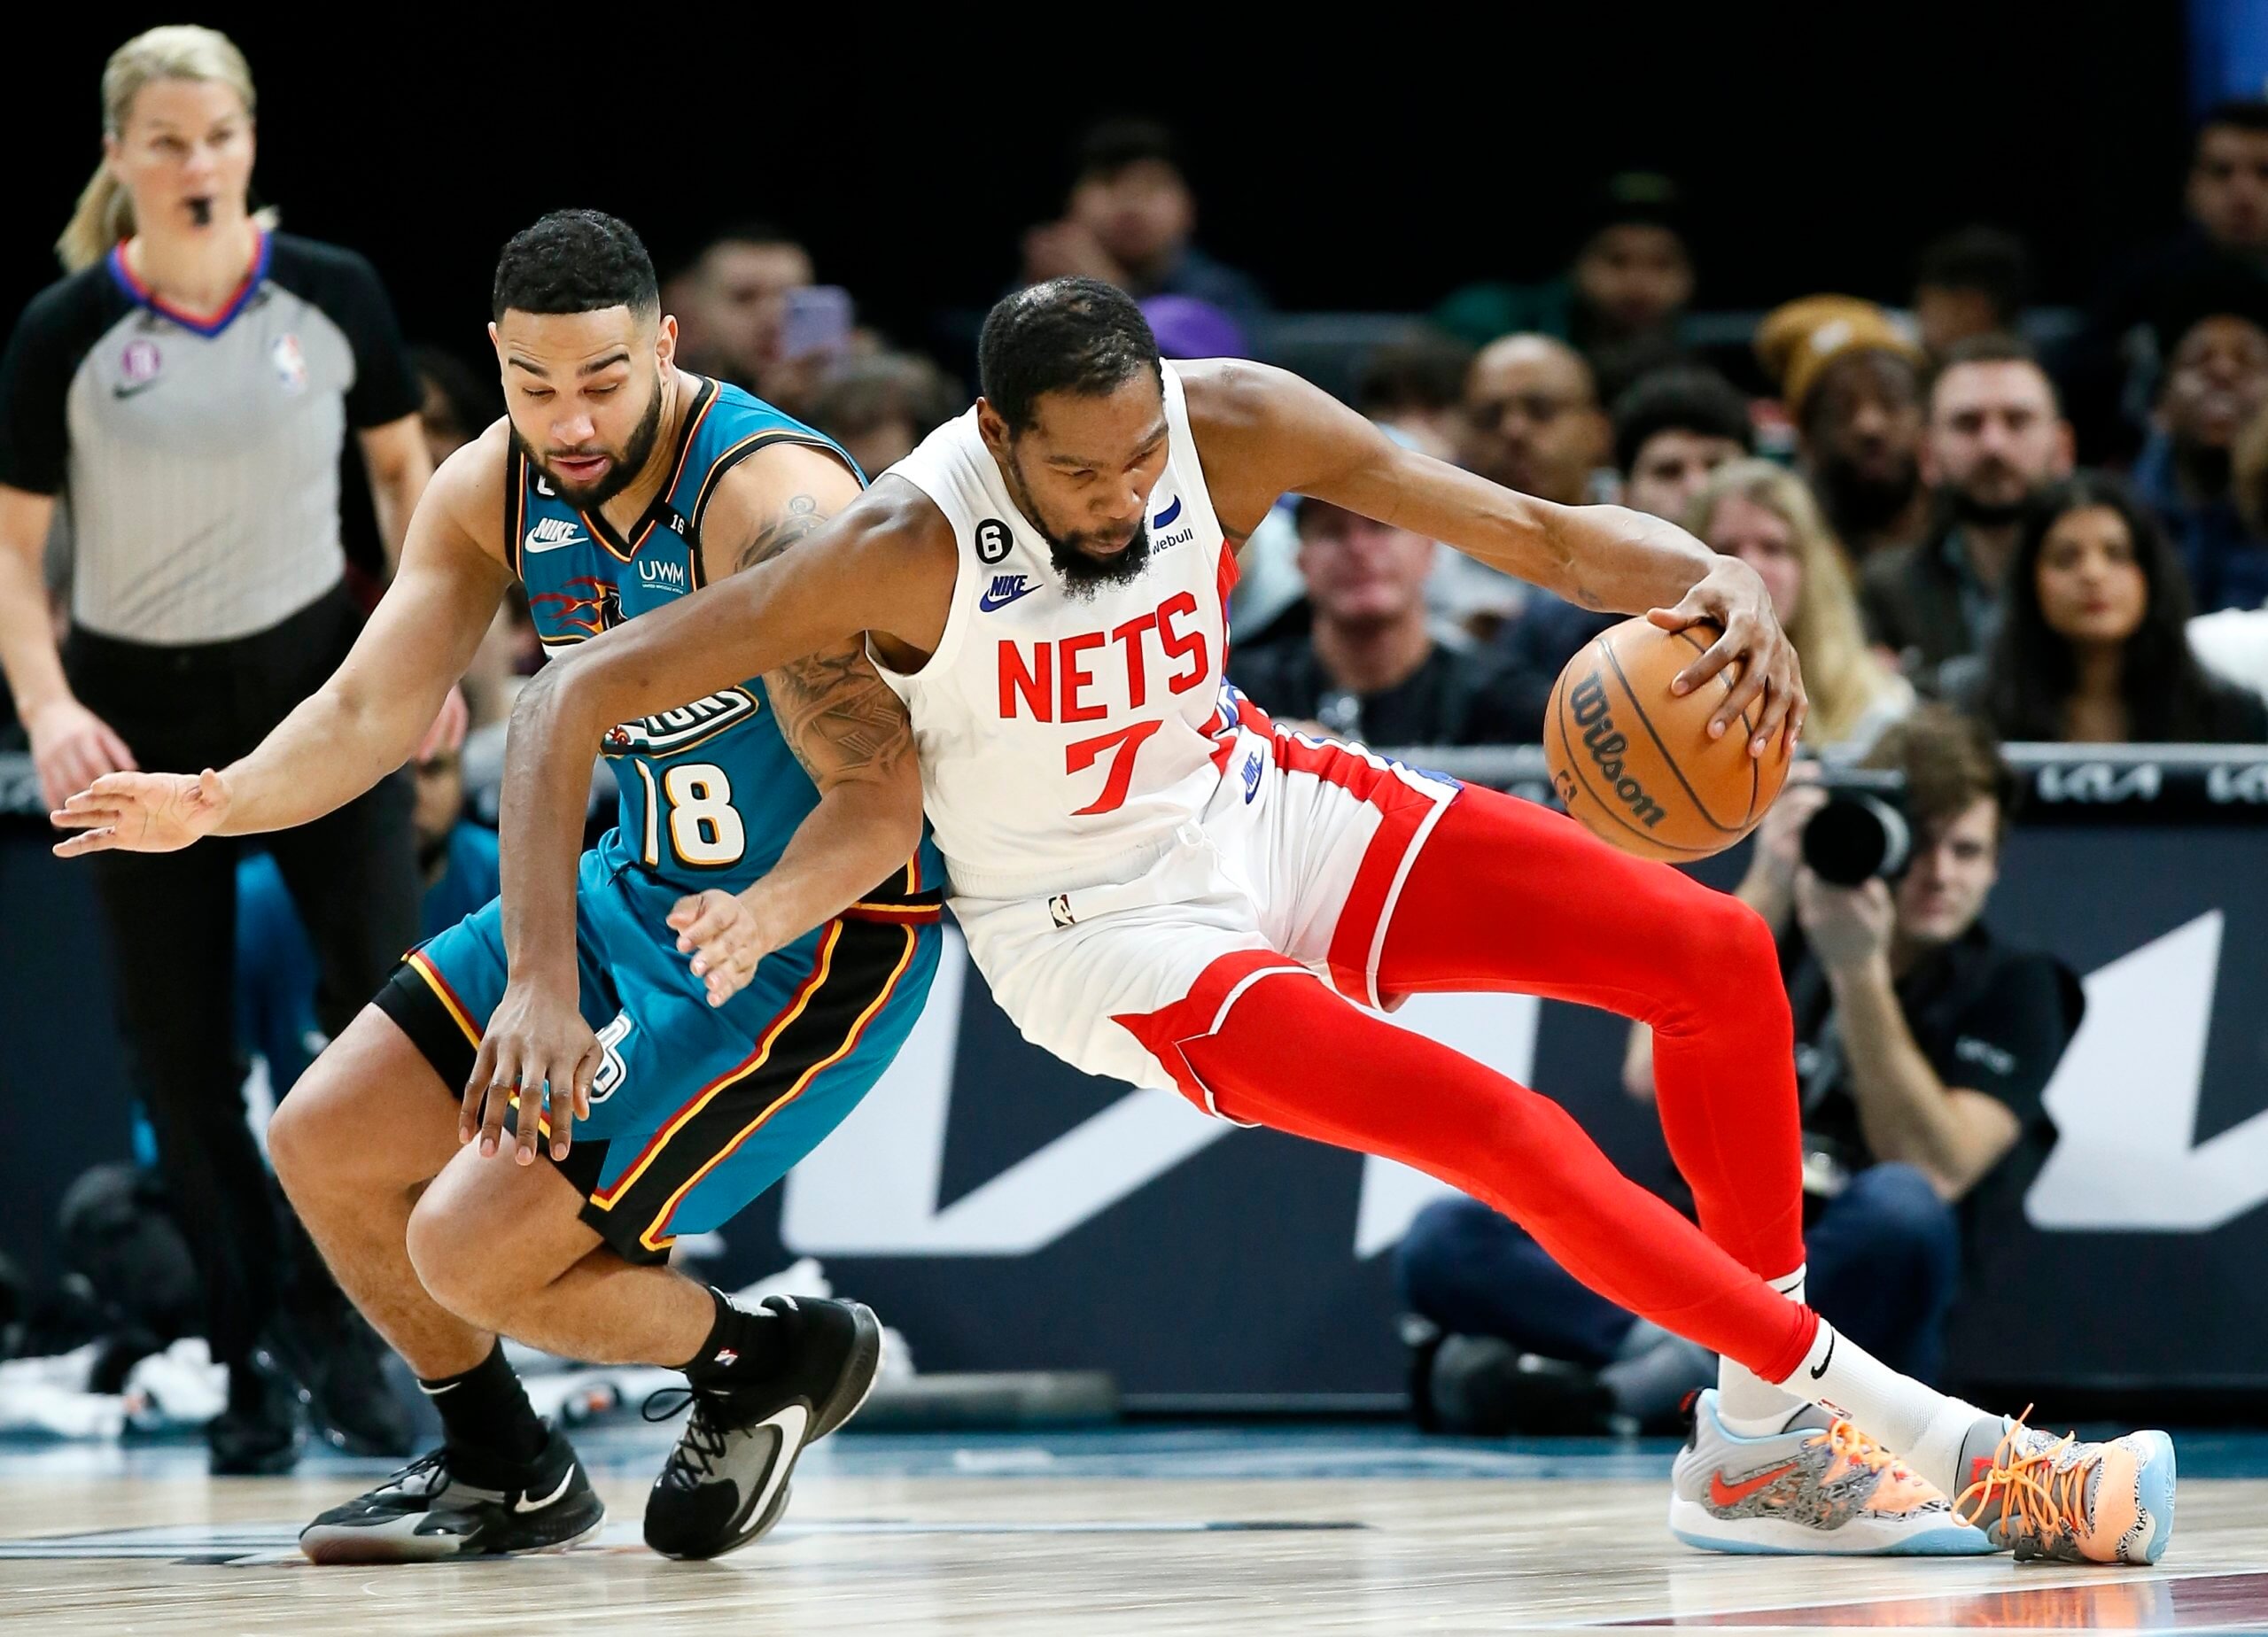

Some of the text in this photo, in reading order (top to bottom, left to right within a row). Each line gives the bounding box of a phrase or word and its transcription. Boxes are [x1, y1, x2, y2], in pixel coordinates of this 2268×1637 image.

[533, 517, 579, 541] NIKE
[671, 514, 685, 535] 16
[980, 525, 1003, 559] 6
[639, 560, 684, 586] UWM
[990, 575, 1029, 597] NIKE
[998, 591, 1208, 724] NETS
[1569, 671, 1666, 828] Wilson
[1066, 719, 1164, 816] 7
[1240, 754, 1261, 790] NIKE
[634, 757, 746, 868] 18
